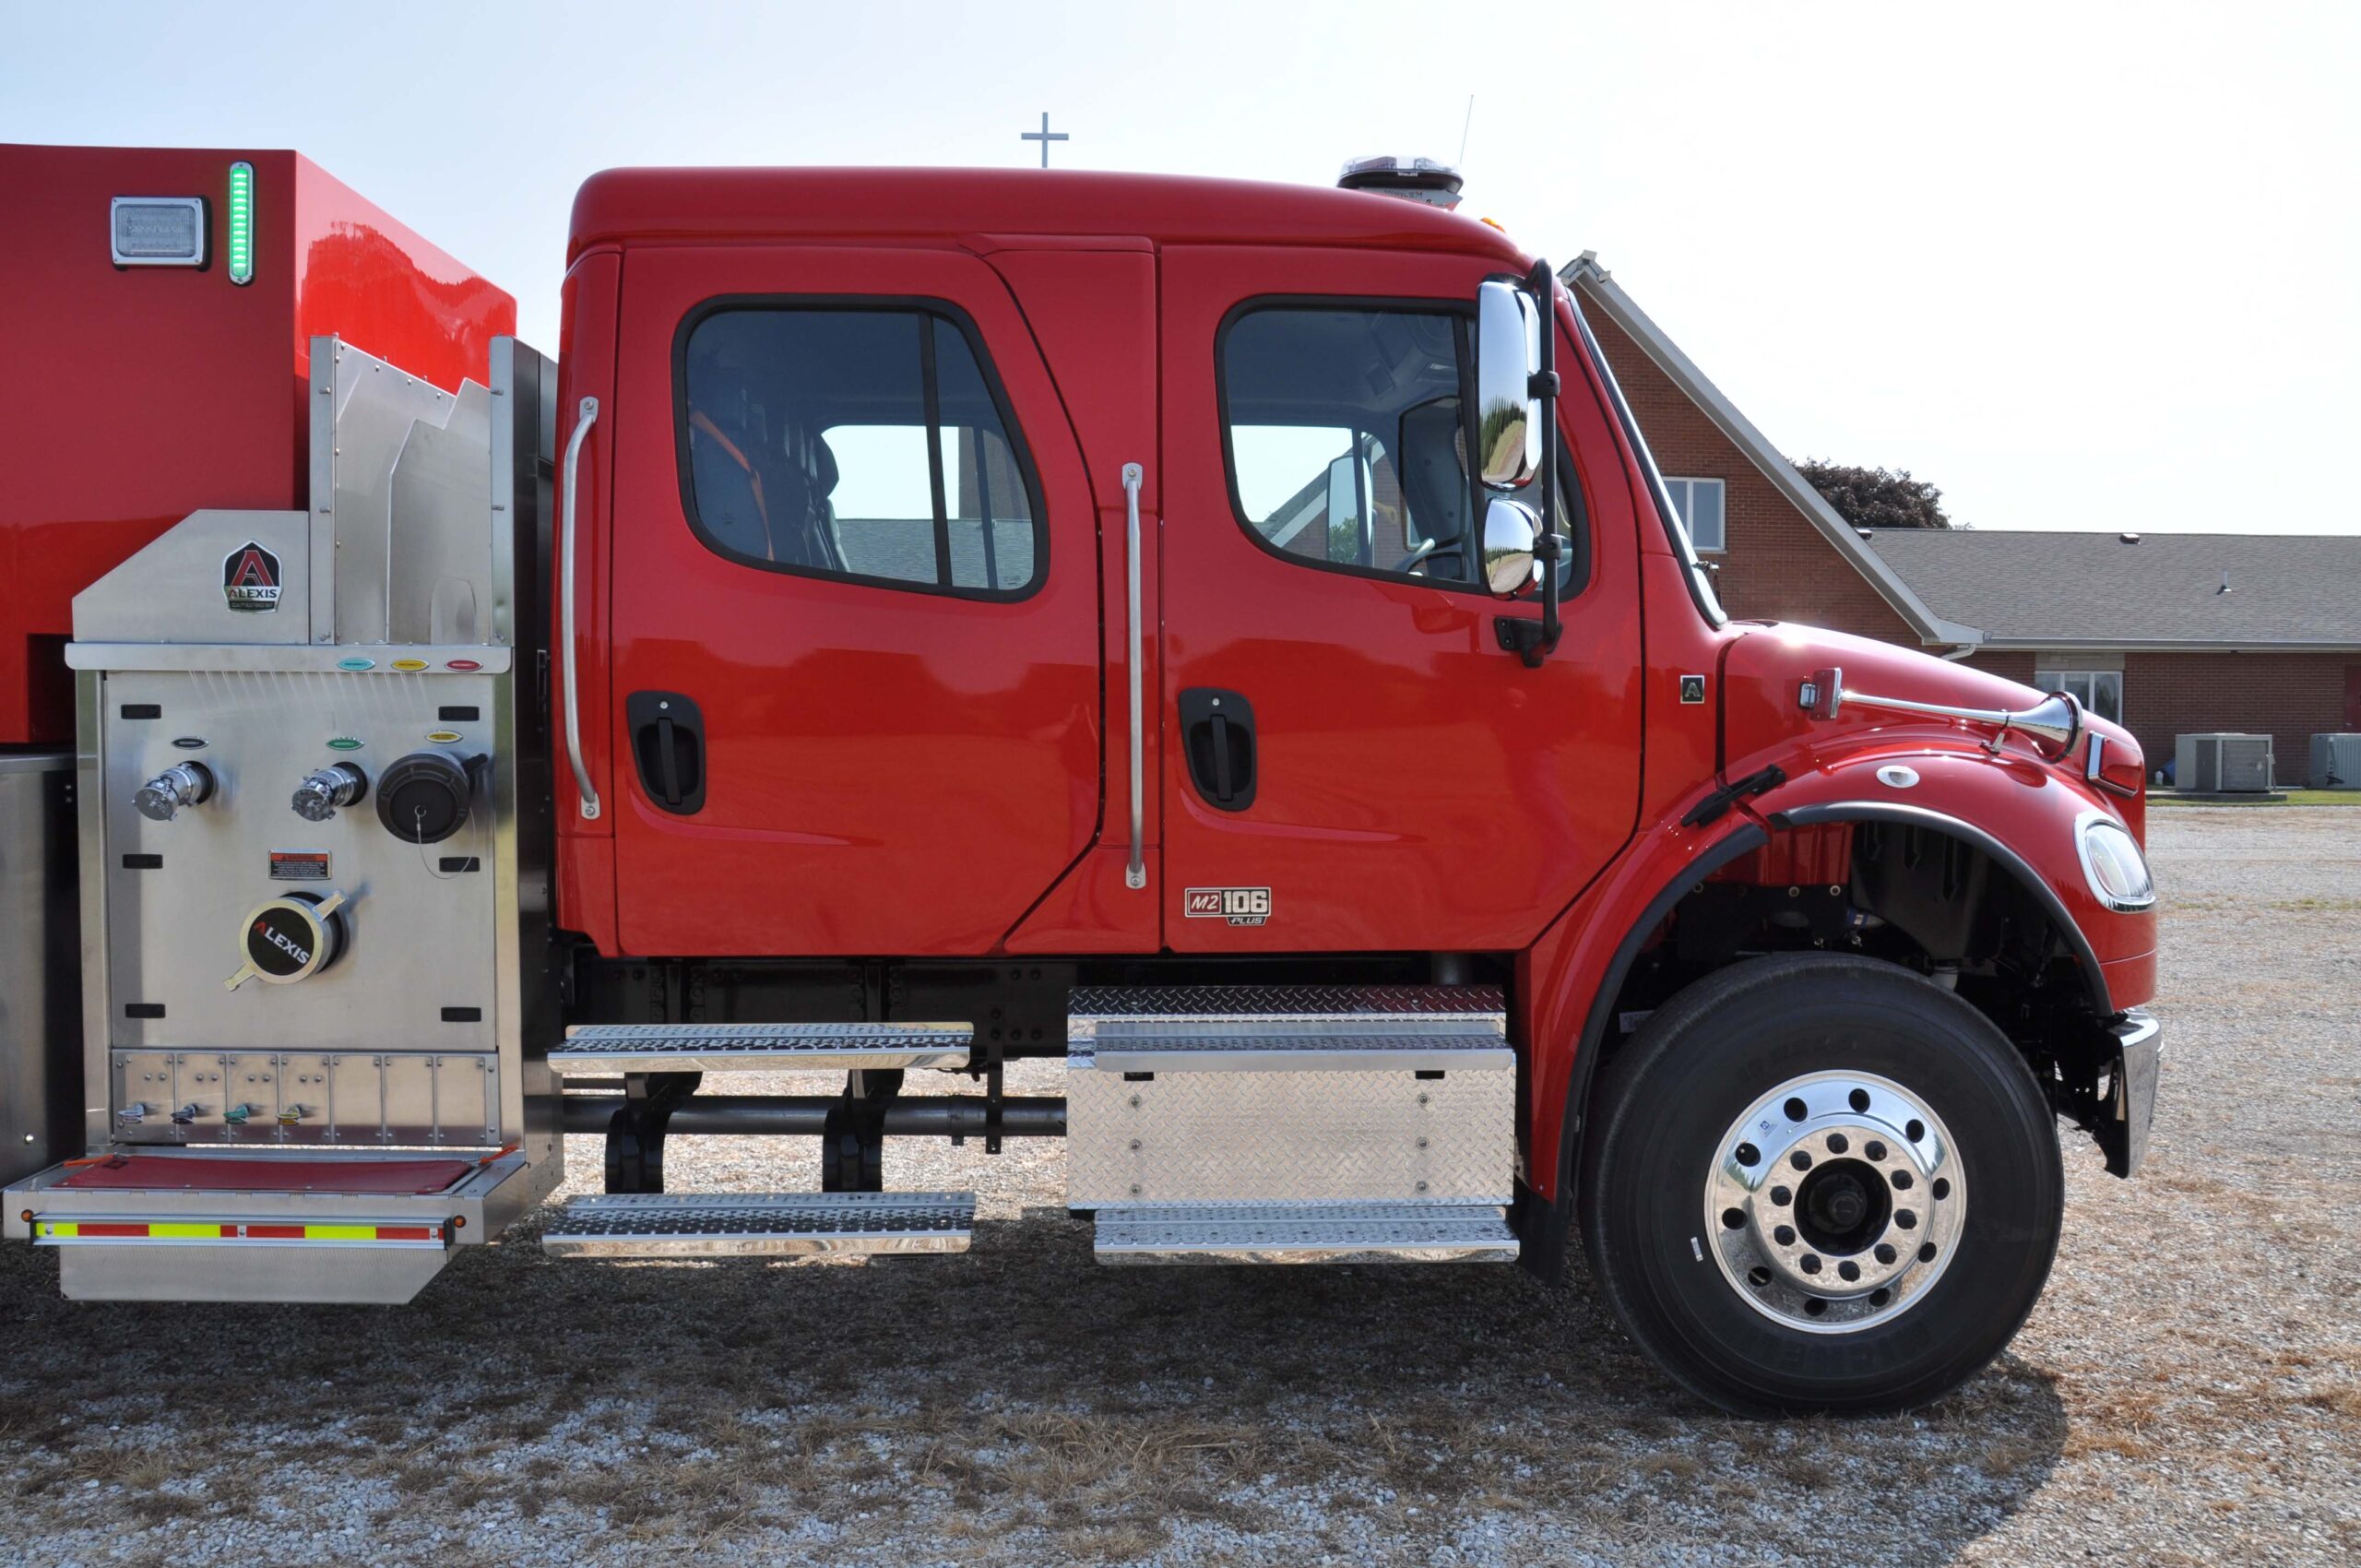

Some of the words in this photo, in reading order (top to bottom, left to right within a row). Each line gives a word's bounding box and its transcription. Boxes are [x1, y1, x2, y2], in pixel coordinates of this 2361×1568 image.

[228, 588, 278, 599] ALEXIS
[1191, 893, 1219, 910] M2
[1223, 890, 1268, 913] 106
[254, 921, 310, 965] ALEXIS
